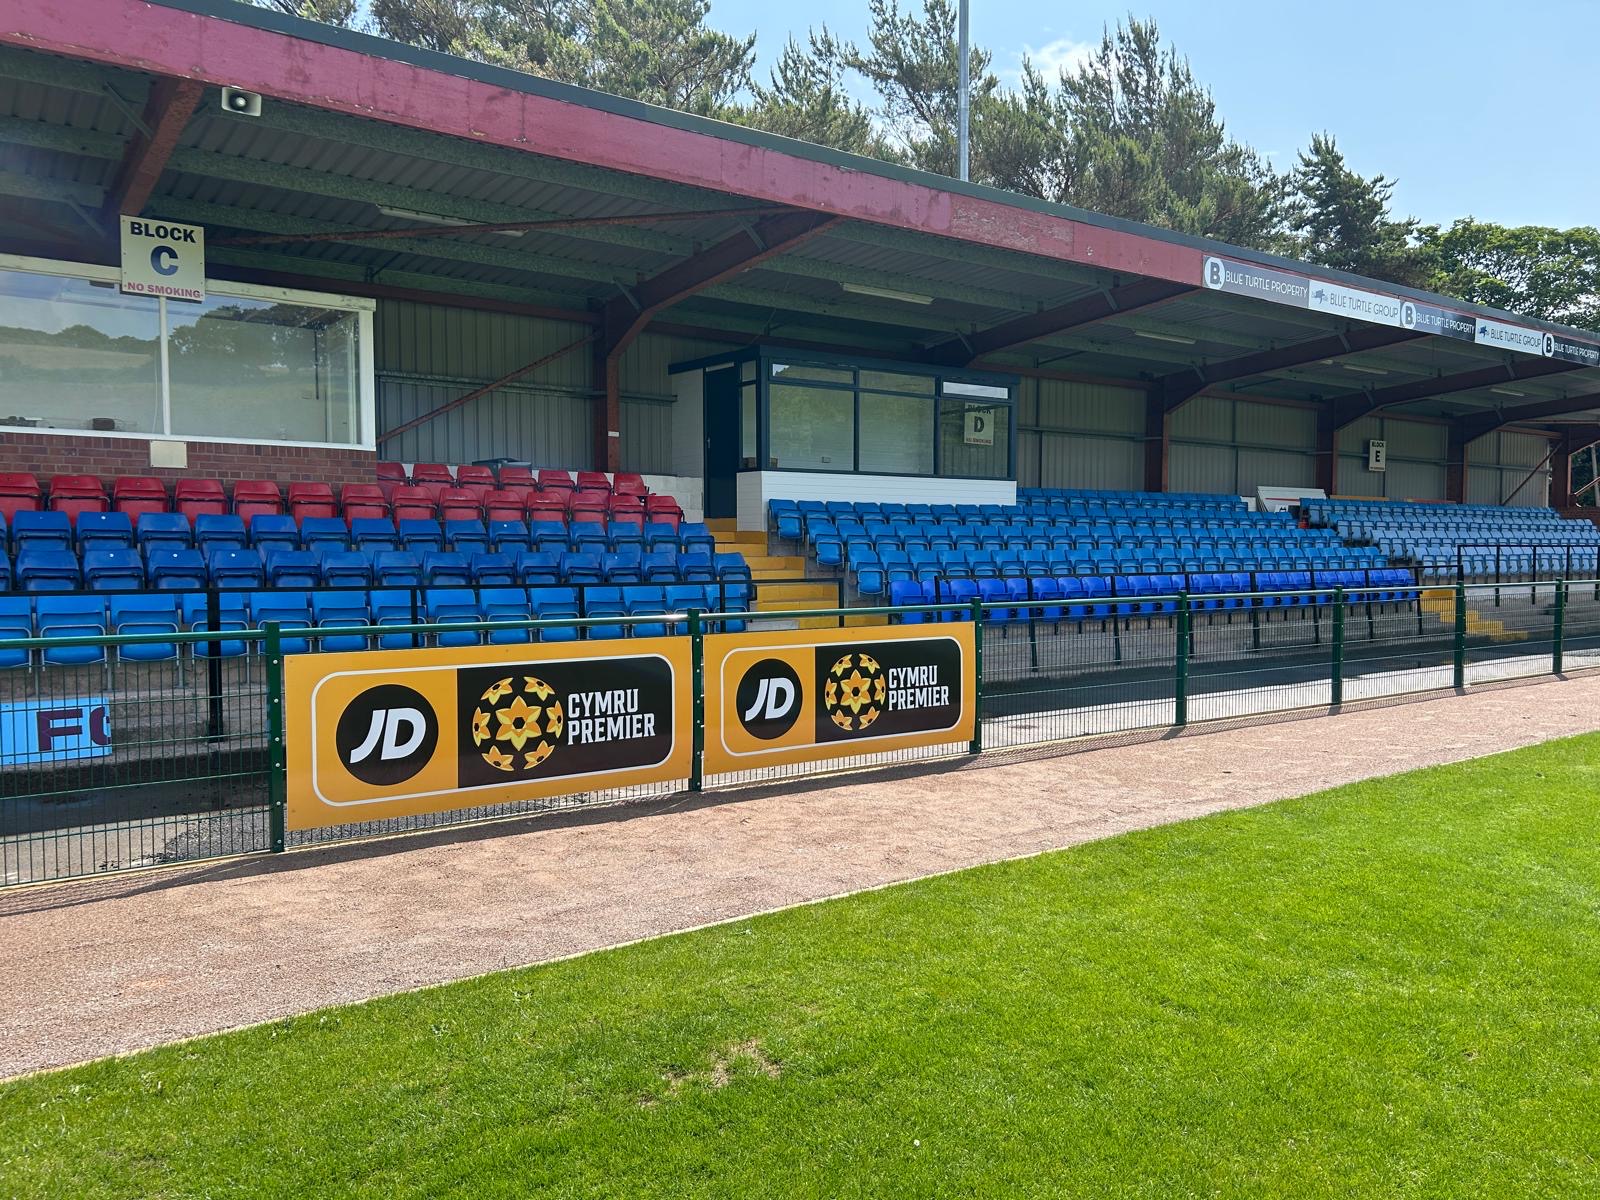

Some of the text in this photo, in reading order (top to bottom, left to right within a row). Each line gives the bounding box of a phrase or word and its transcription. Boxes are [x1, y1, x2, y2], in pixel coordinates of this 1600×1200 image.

[130, 221, 196, 243] BLOCK
[150, 245, 179, 276] C
[127, 282, 201, 298] NO SMOKING
[1225, 270, 1309, 298] BLUE TURTLE PROPERTY
[1330, 293, 1399, 318] BLUE TURTLE GROUP
[1416, 312, 1475, 334] BLUE TURTLE PROPERTY
[1490, 328, 1542, 348] BLUE TURTLE GROUP
[974, 416, 984, 432] D
[1375, 450, 1380, 462] E
[888, 665, 938, 689] CYMRU
[567, 688, 639, 718] CYMRU
[744, 677, 796, 722] JD
[888, 685, 950, 712] PREMIER
[350, 707, 427, 764] JD
[567, 712, 656, 746] PREMIER
